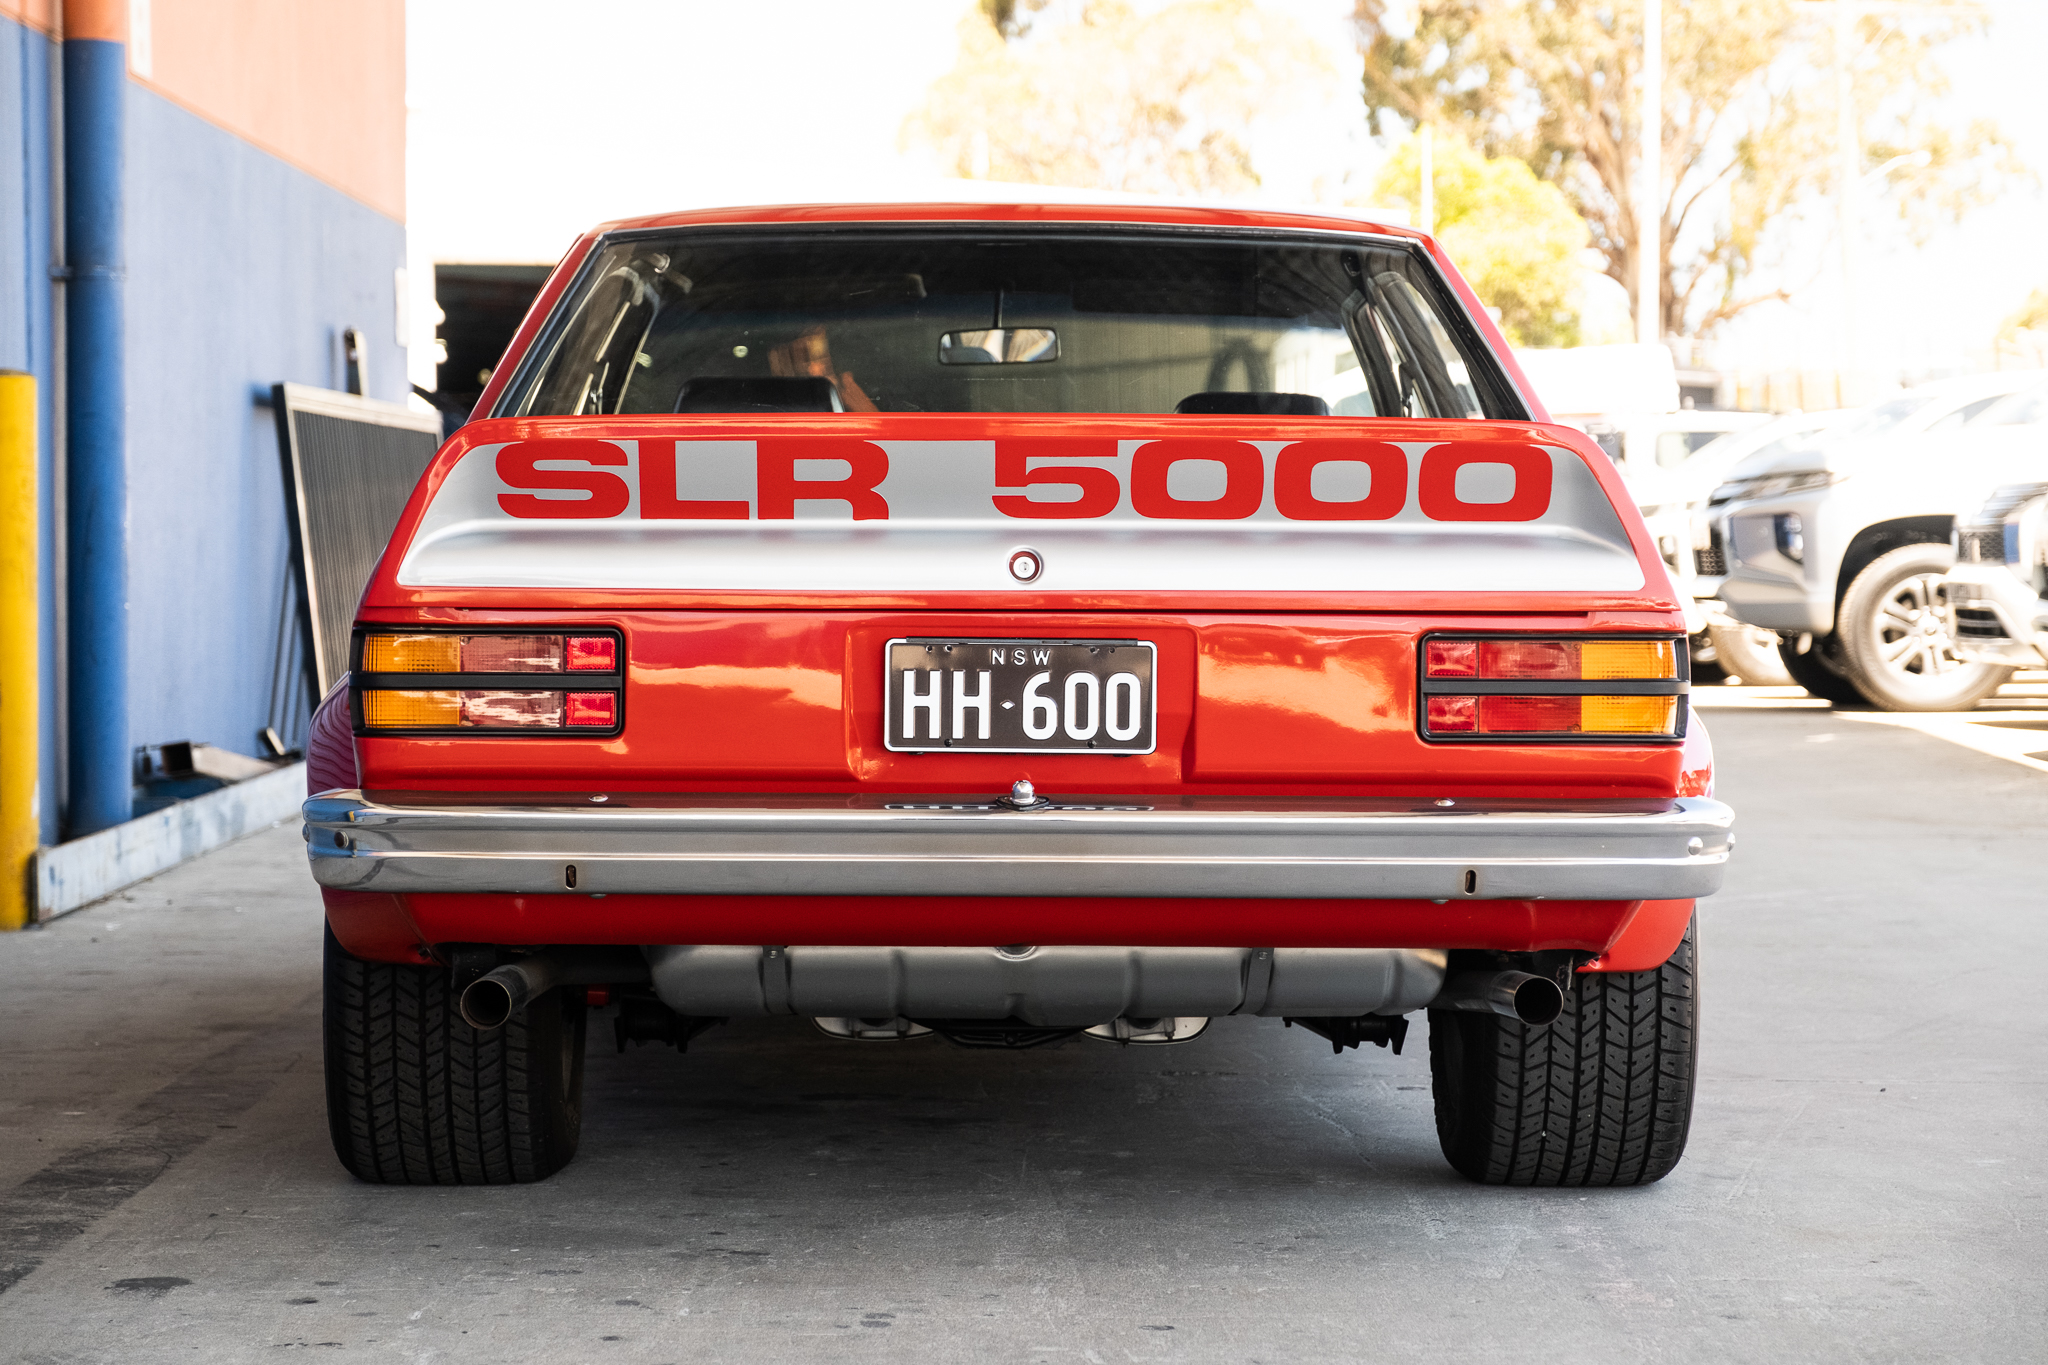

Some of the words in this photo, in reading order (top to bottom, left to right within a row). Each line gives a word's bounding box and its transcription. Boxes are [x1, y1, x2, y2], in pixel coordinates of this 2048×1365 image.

[495, 439, 889, 520] SLR
[991, 439, 1553, 521] 5000
[991, 649, 1051, 666] NSW
